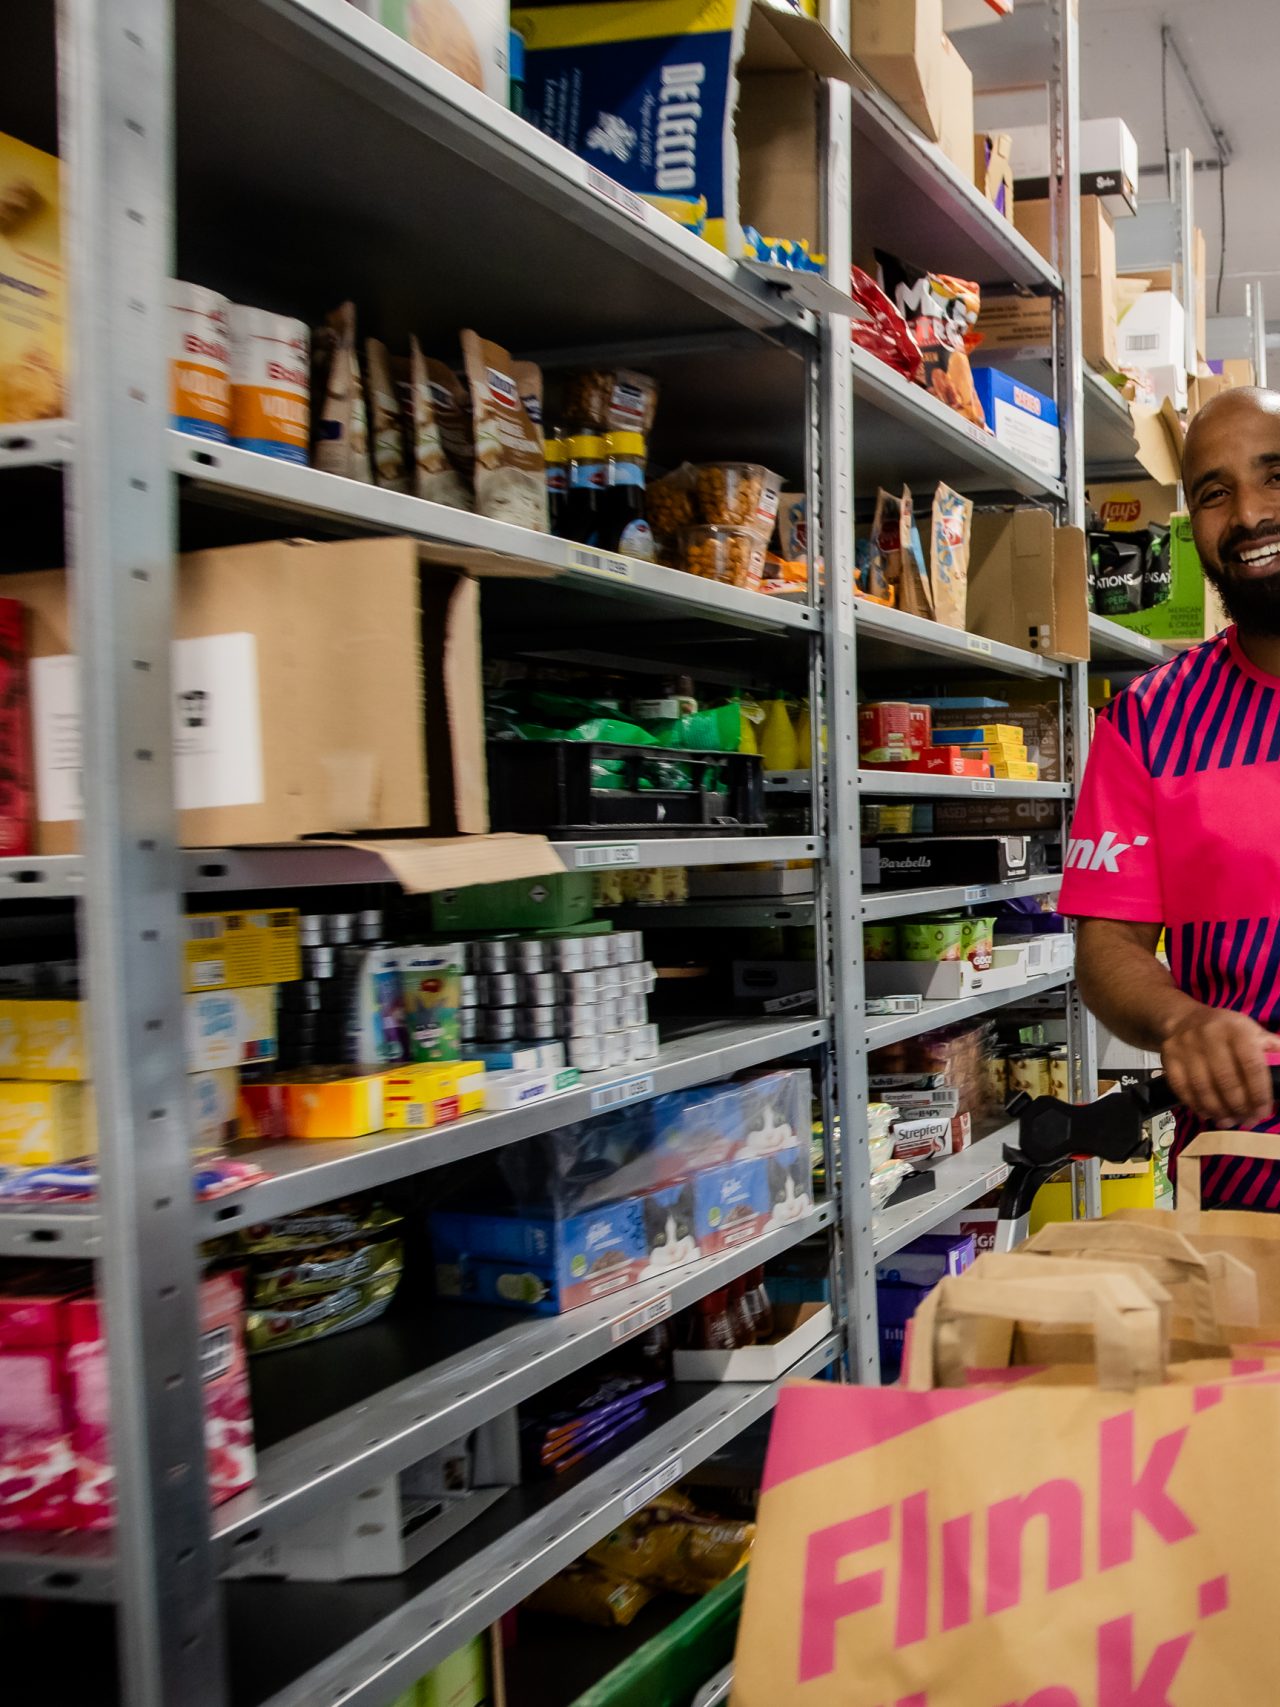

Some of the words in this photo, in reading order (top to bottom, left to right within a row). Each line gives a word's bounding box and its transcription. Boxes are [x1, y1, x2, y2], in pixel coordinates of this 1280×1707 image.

[880, 856, 932, 869] Barebells
[898, 1124, 943, 1141] Strepfen
[798, 1410, 1198, 1684] Flink
